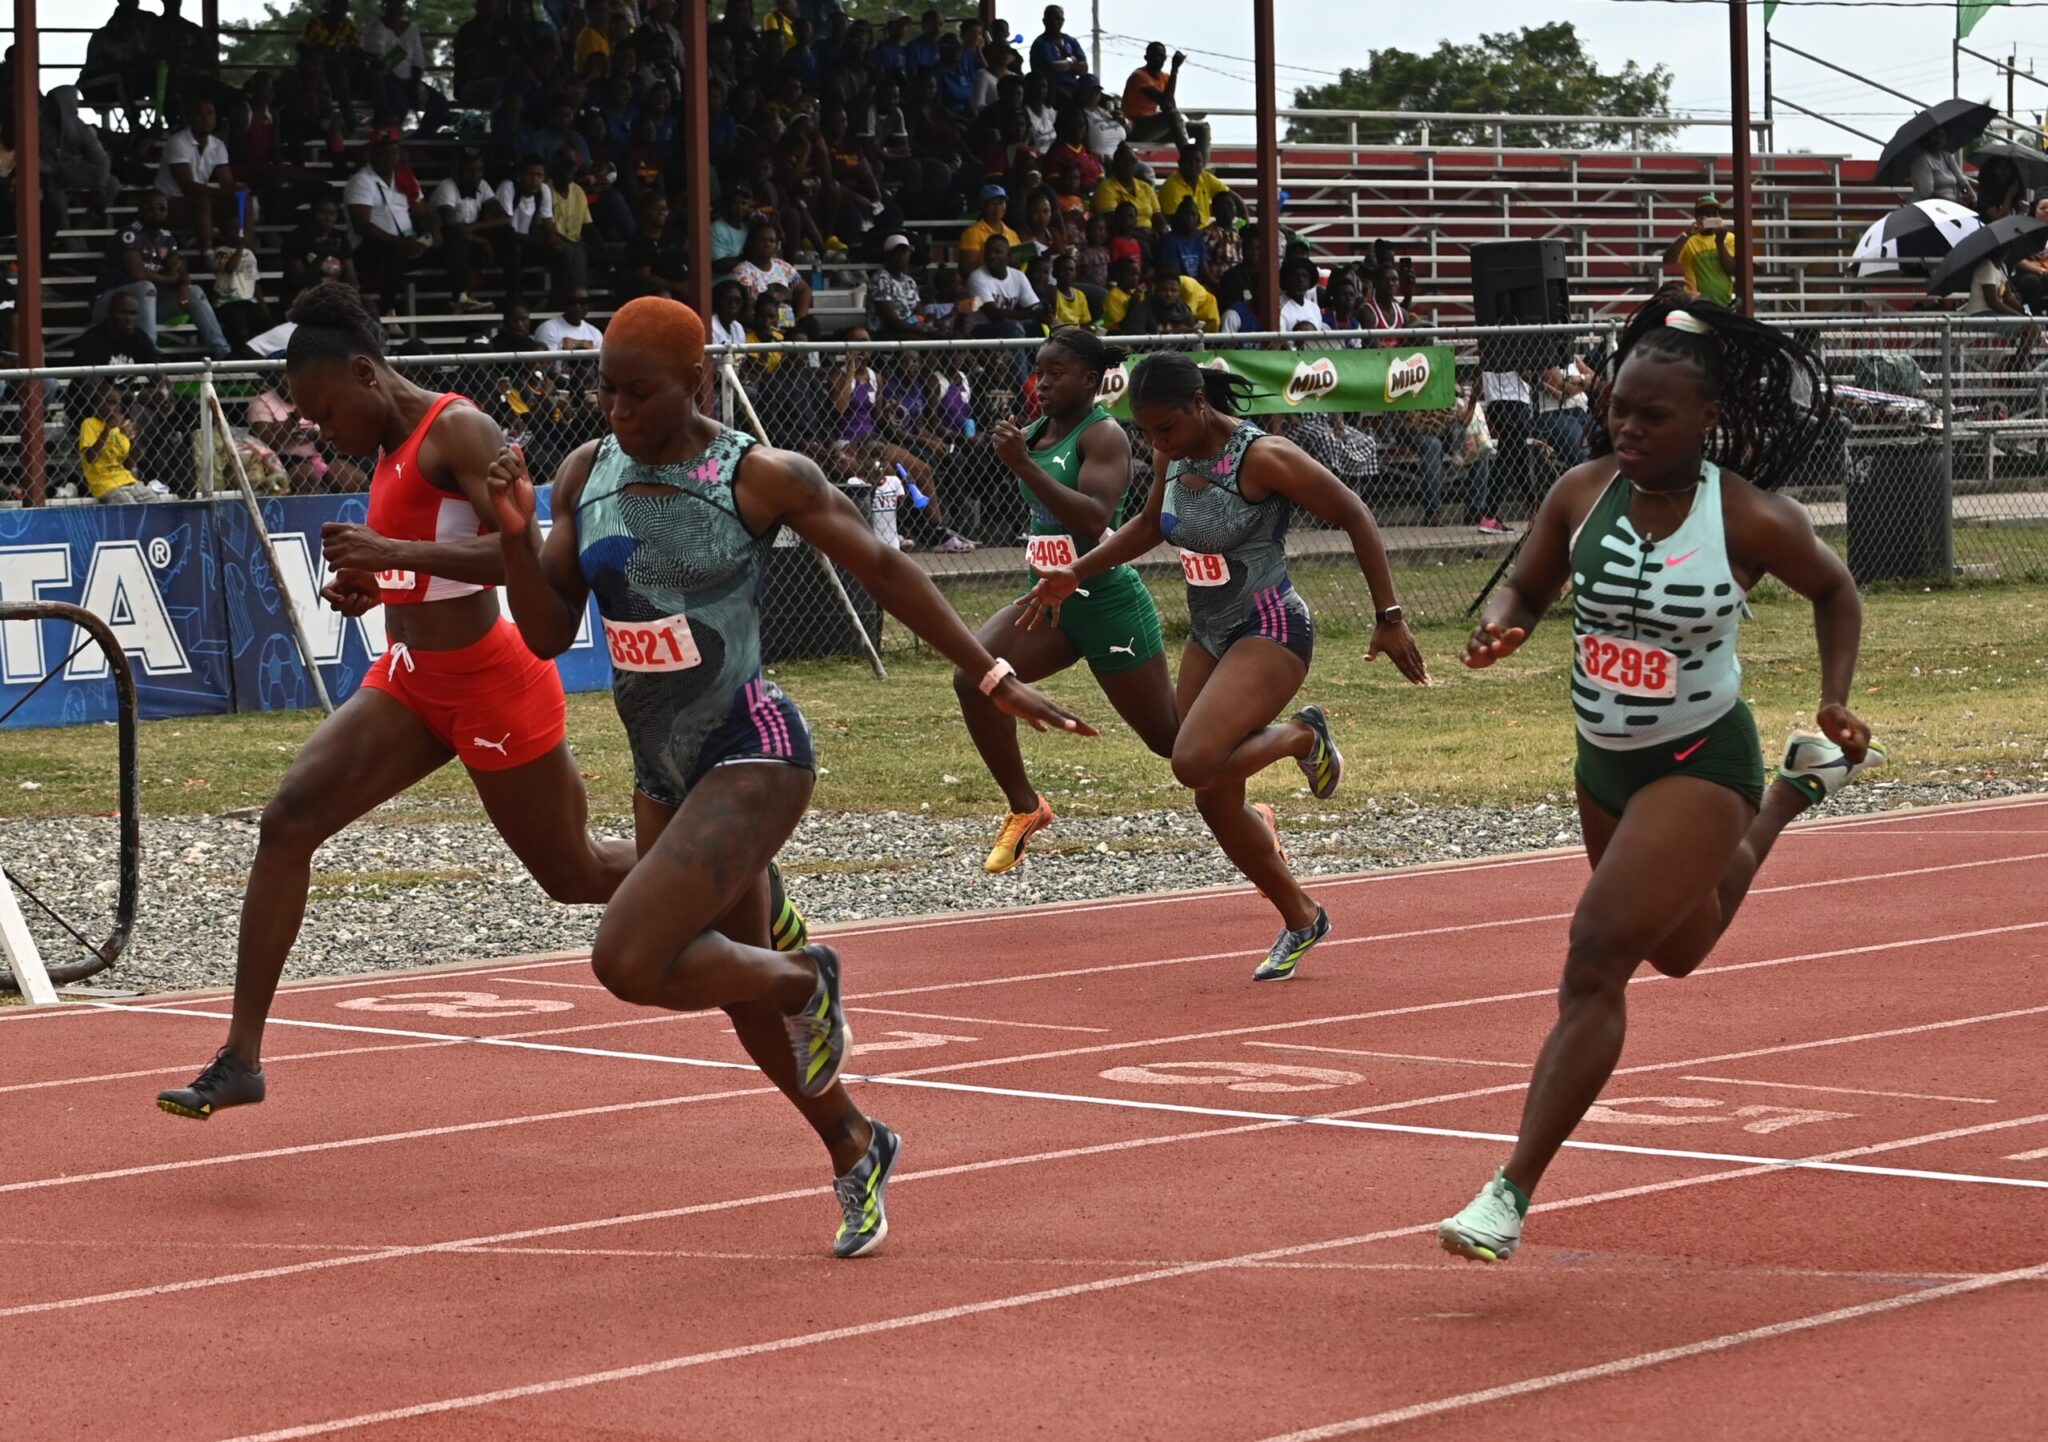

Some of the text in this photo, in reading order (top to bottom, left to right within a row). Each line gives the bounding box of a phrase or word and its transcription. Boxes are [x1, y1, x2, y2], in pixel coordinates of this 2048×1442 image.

[1289, 370, 1334, 394] MILO
[1391, 365, 1426, 393] MILO
[1028, 539, 1073, 566] 3403
[606, 625, 684, 665] 3321
[1584, 635, 1667, 690] 3293
